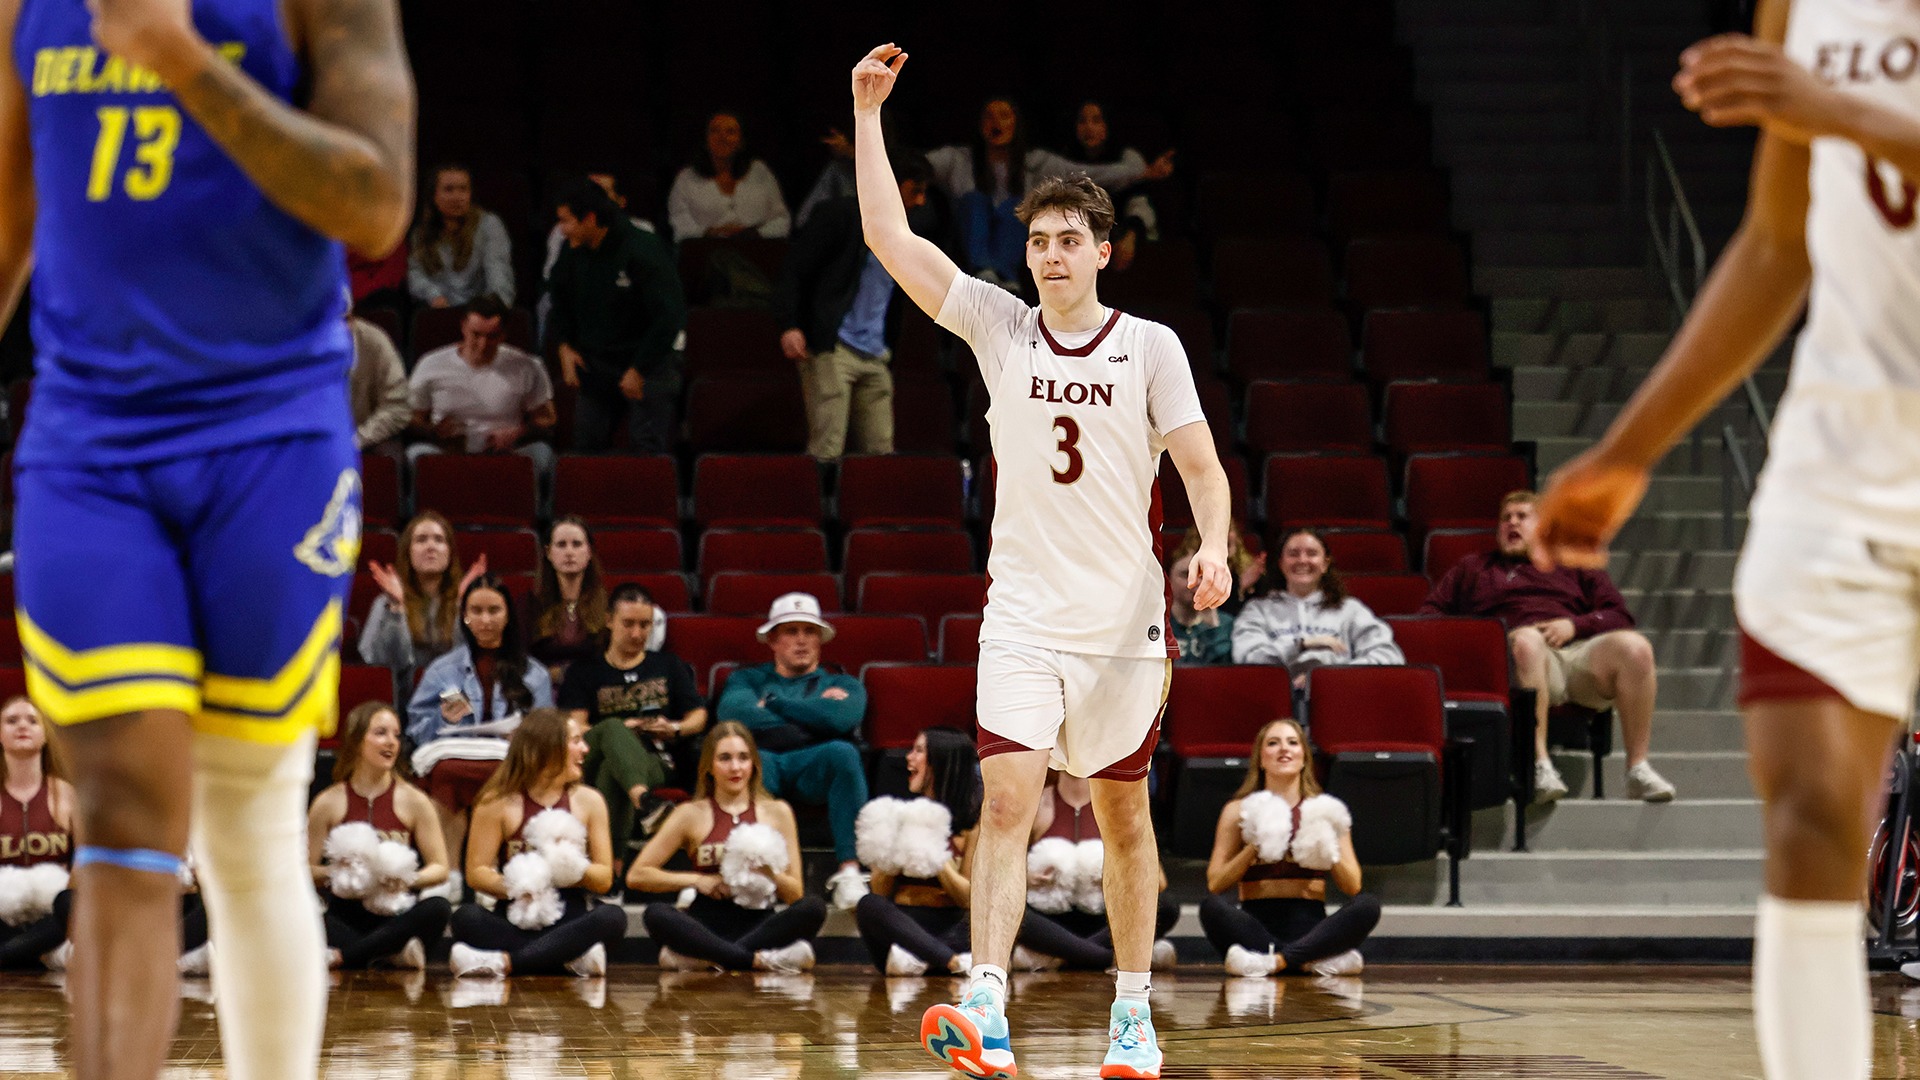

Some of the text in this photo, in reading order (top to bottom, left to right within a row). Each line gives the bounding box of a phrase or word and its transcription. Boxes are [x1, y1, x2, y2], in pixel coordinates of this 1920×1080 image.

[32, 42, 247, 97] DELAW
[1817, 36, 1920, 84] ELO
[86, 106, 182, 201] 13
[1108, 354, 1128, 363] CAA
[1029, 376, 1114, 406] ELON
[1050, 414, 1085, 486] 3
[0, 832, 68, 858] LON
